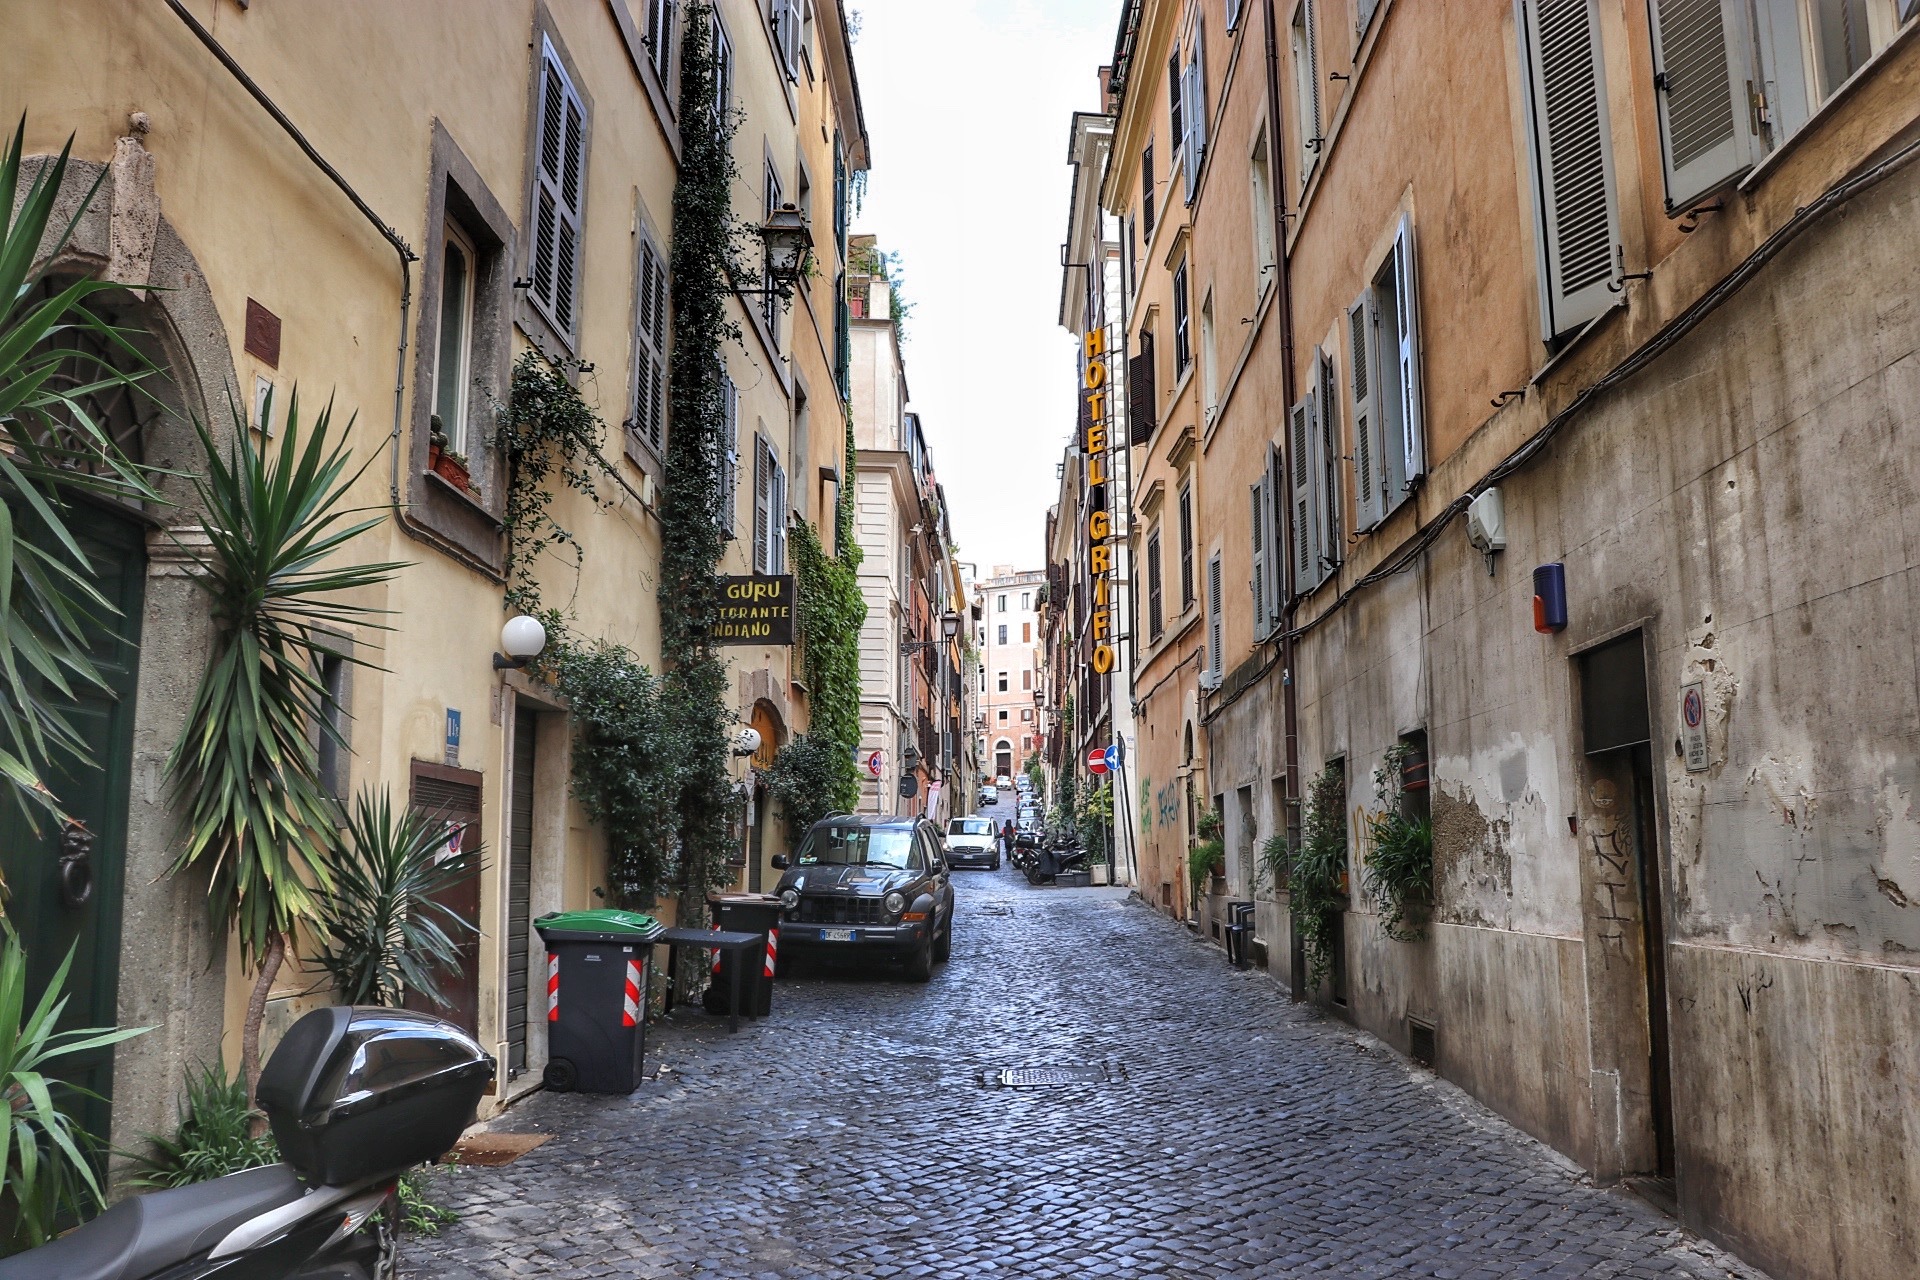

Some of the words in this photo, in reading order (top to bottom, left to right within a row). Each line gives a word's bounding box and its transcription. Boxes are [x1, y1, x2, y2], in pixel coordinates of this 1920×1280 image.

[1086, 327, 1106, 486] HOTEL
[719, 606, 789, 619] TORANTE
[727, 580, 780, 602] GURU
[1089, 510, 1115, 675] GRIFO
